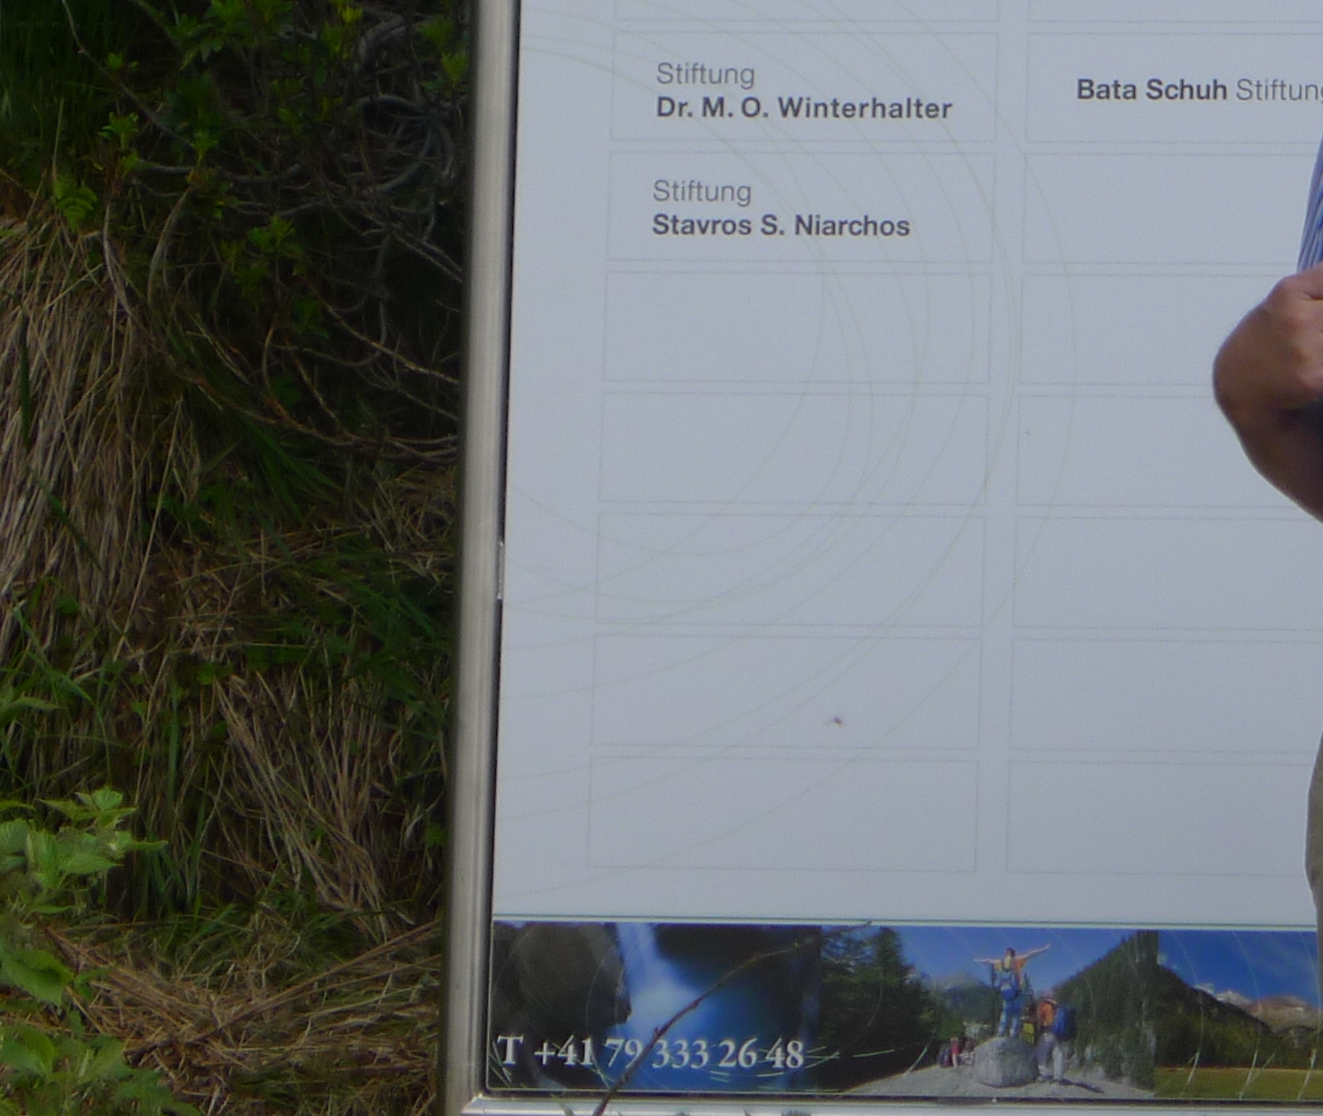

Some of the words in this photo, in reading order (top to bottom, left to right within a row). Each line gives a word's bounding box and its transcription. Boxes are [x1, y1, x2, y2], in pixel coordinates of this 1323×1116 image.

[657, 62, 755, 90] Stiftung
[1077, 78, 1137, 100] Bata
[1146, 78, 1227, 100] Schuh
[657, 96, 692, 117] Dr.
[702, 96, 733, 117] M.
[741, 96, 768, 118] O.
[778, 97, 952, 119] Winterhalter
[653, 179, 751, 207] Stiftung
[653, 213, 752, 235] Stavros
[761, 214, 784, 235] S.
[795, 214, 910, 236] Niarchos
[497, 1036, 523, 1066] T
[534, 1036, 595, 1067] +41
[605, 1038, 643, 1069] 79
[652, 1039, 708, 1069] 333
[719, 1039, 757, 1069] 26
[765, 1039, 803, 1069] 48
